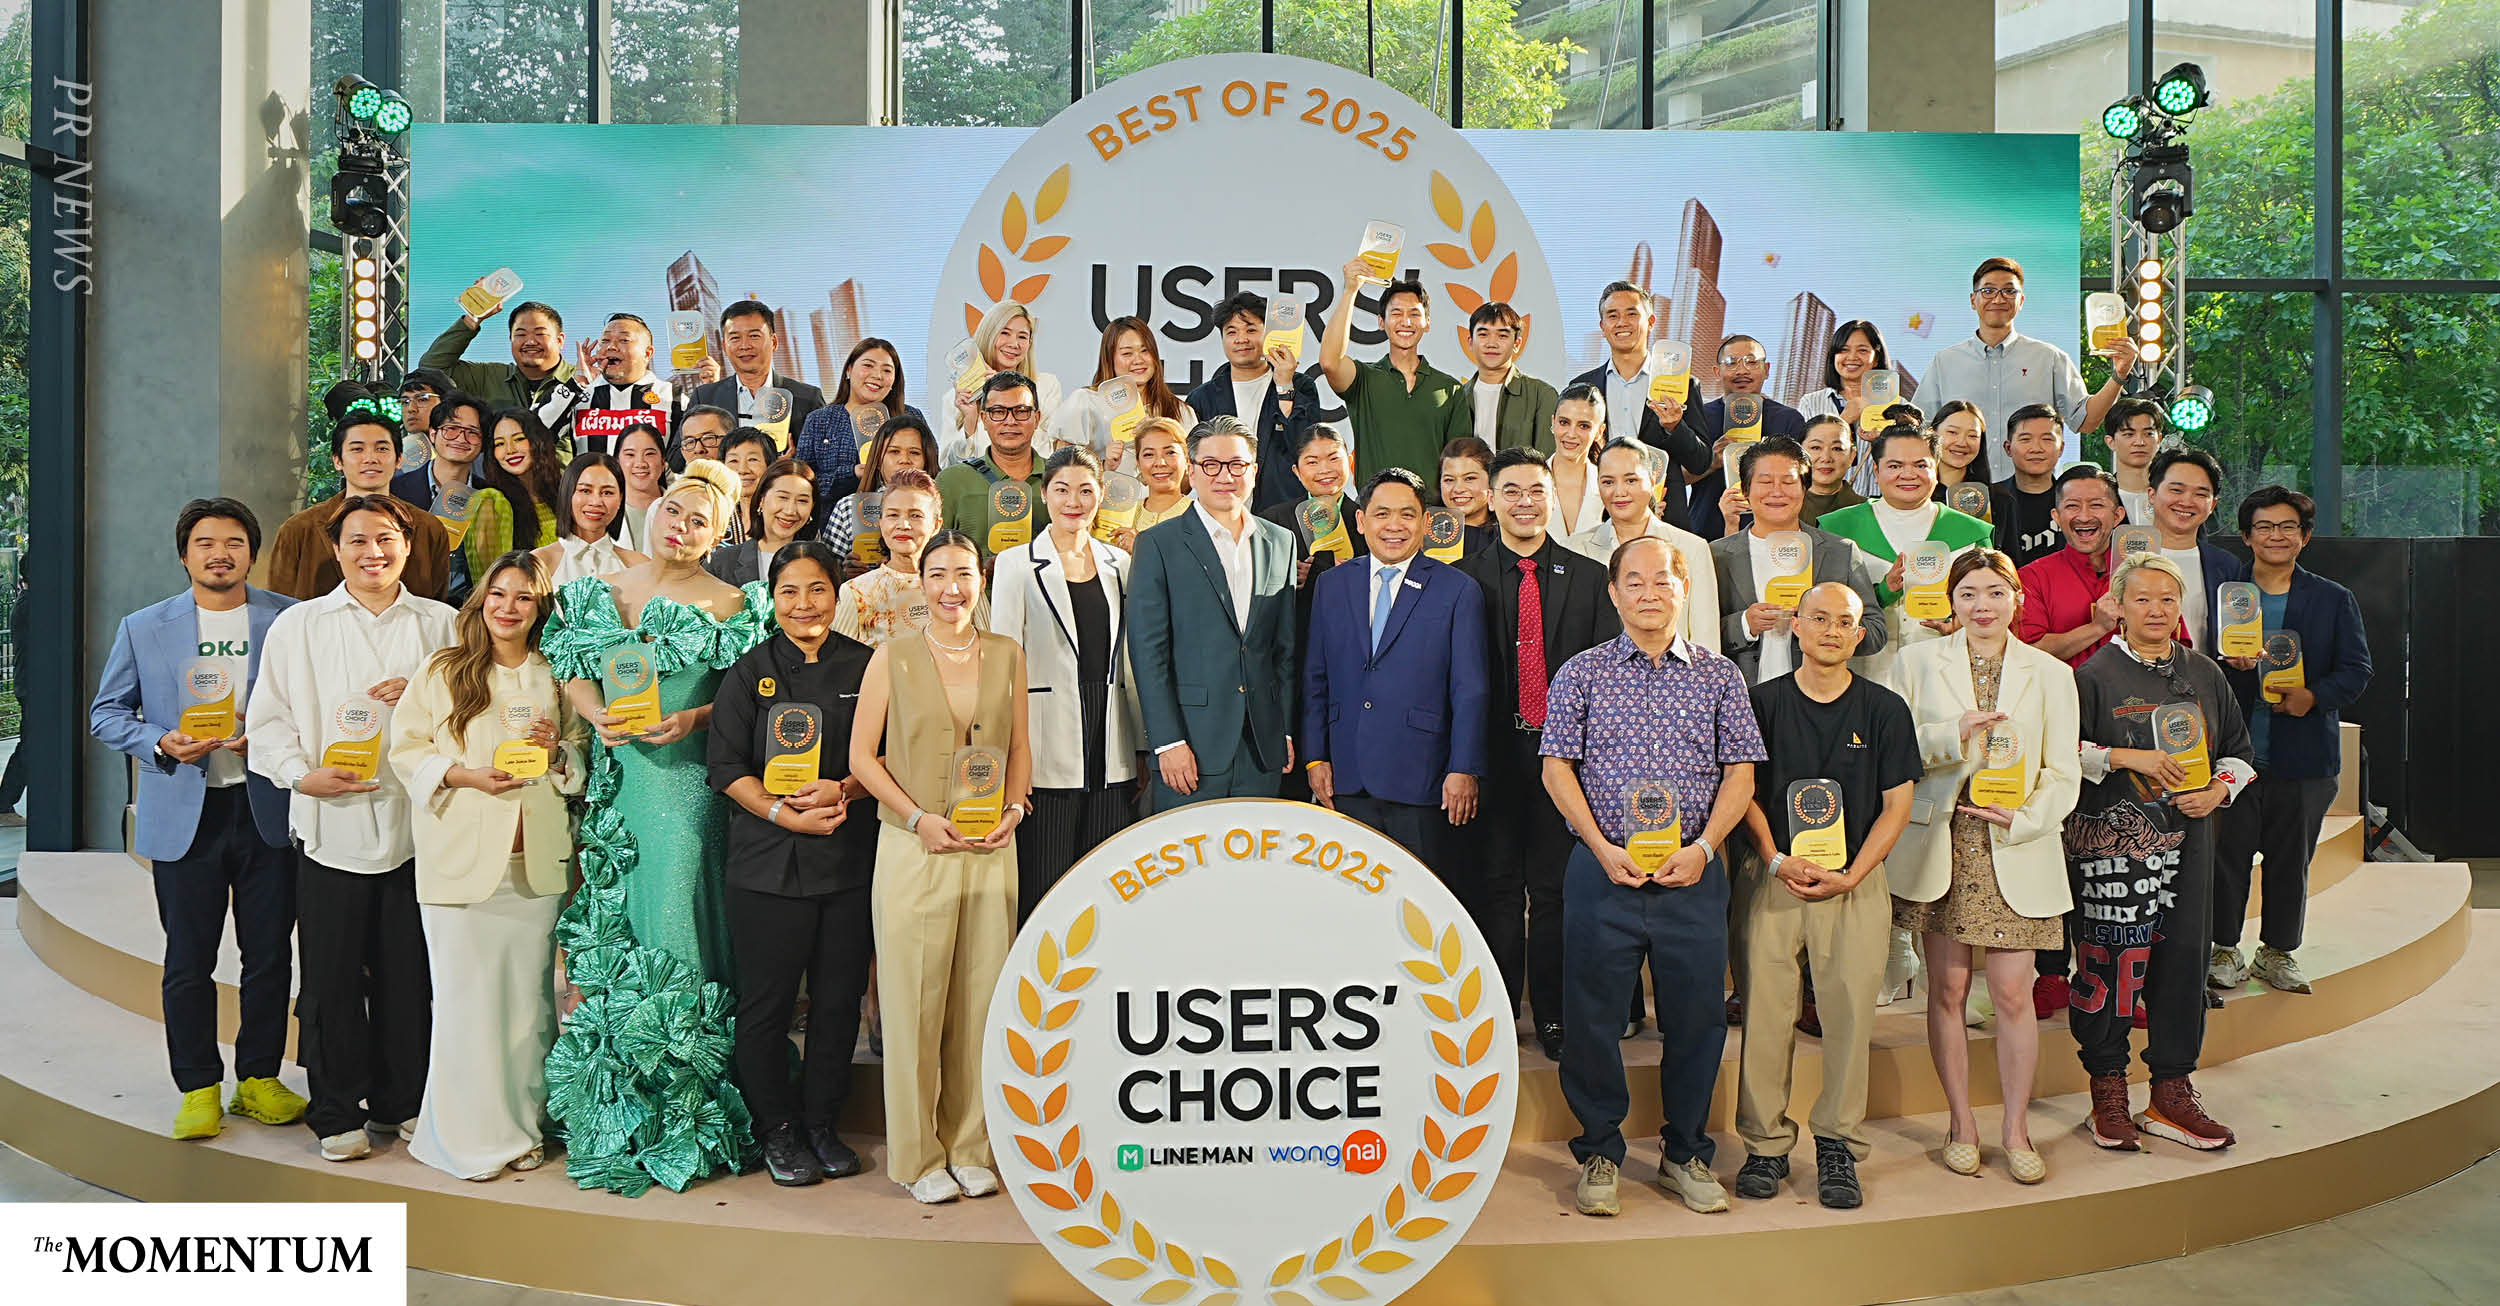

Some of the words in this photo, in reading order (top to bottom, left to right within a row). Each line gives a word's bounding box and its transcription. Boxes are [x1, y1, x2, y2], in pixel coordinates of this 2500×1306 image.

[1088, 86, 1202, 160] BEST
[1223, 81, 1288, 116] OF
[1302, 89, 1416, 160] 2025
[198, 641, 249, 657] OKJ
[1110, 834, 1206, 901] BEST
[1224, 829, 1280, 859] OF
[1293, 834, 1392, 893] 2025
[2080, 856, 2130, 877] THE
[2145, 849, 2181, 871] OE
[2081, 881, 2129, 898] AND
[2134, 869, 2179, 895] ONY
[2083, 902, 2139, 923] BILLY
[1117, 986, 1398, 1056] USERS'
[1118, 1066, 1381, 1123] CHOICE
